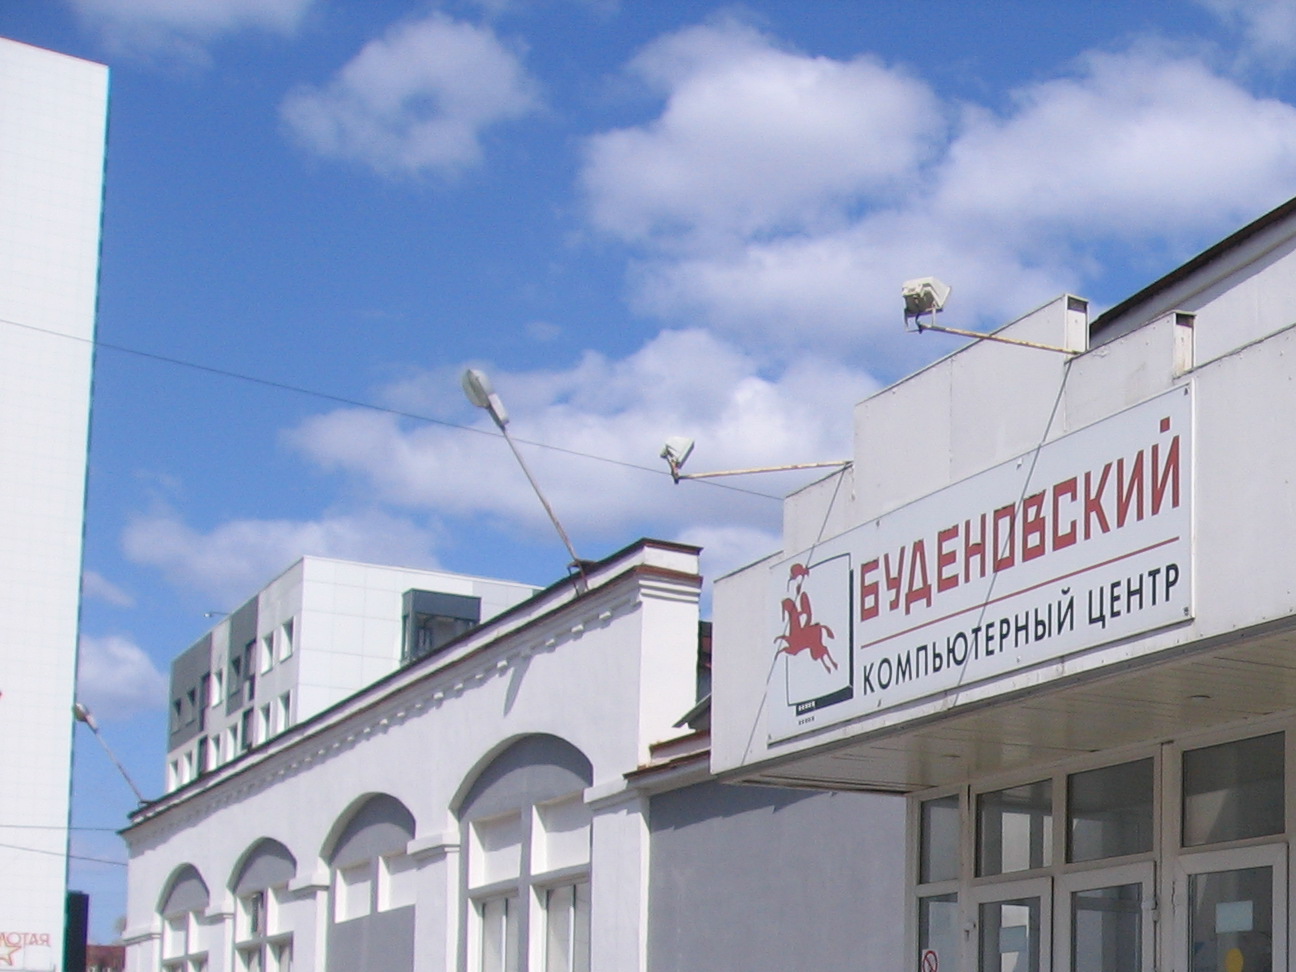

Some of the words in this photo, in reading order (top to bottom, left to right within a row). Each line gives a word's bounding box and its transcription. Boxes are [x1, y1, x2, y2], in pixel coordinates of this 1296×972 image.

[860, 416, 1180, 622] БУДЕНОВСКИЙ
[863, 586, 1075, 695] КОМПЬЮТЕРНЫЙ
[1088, 563, 1180, 630] ЦЕНТР
